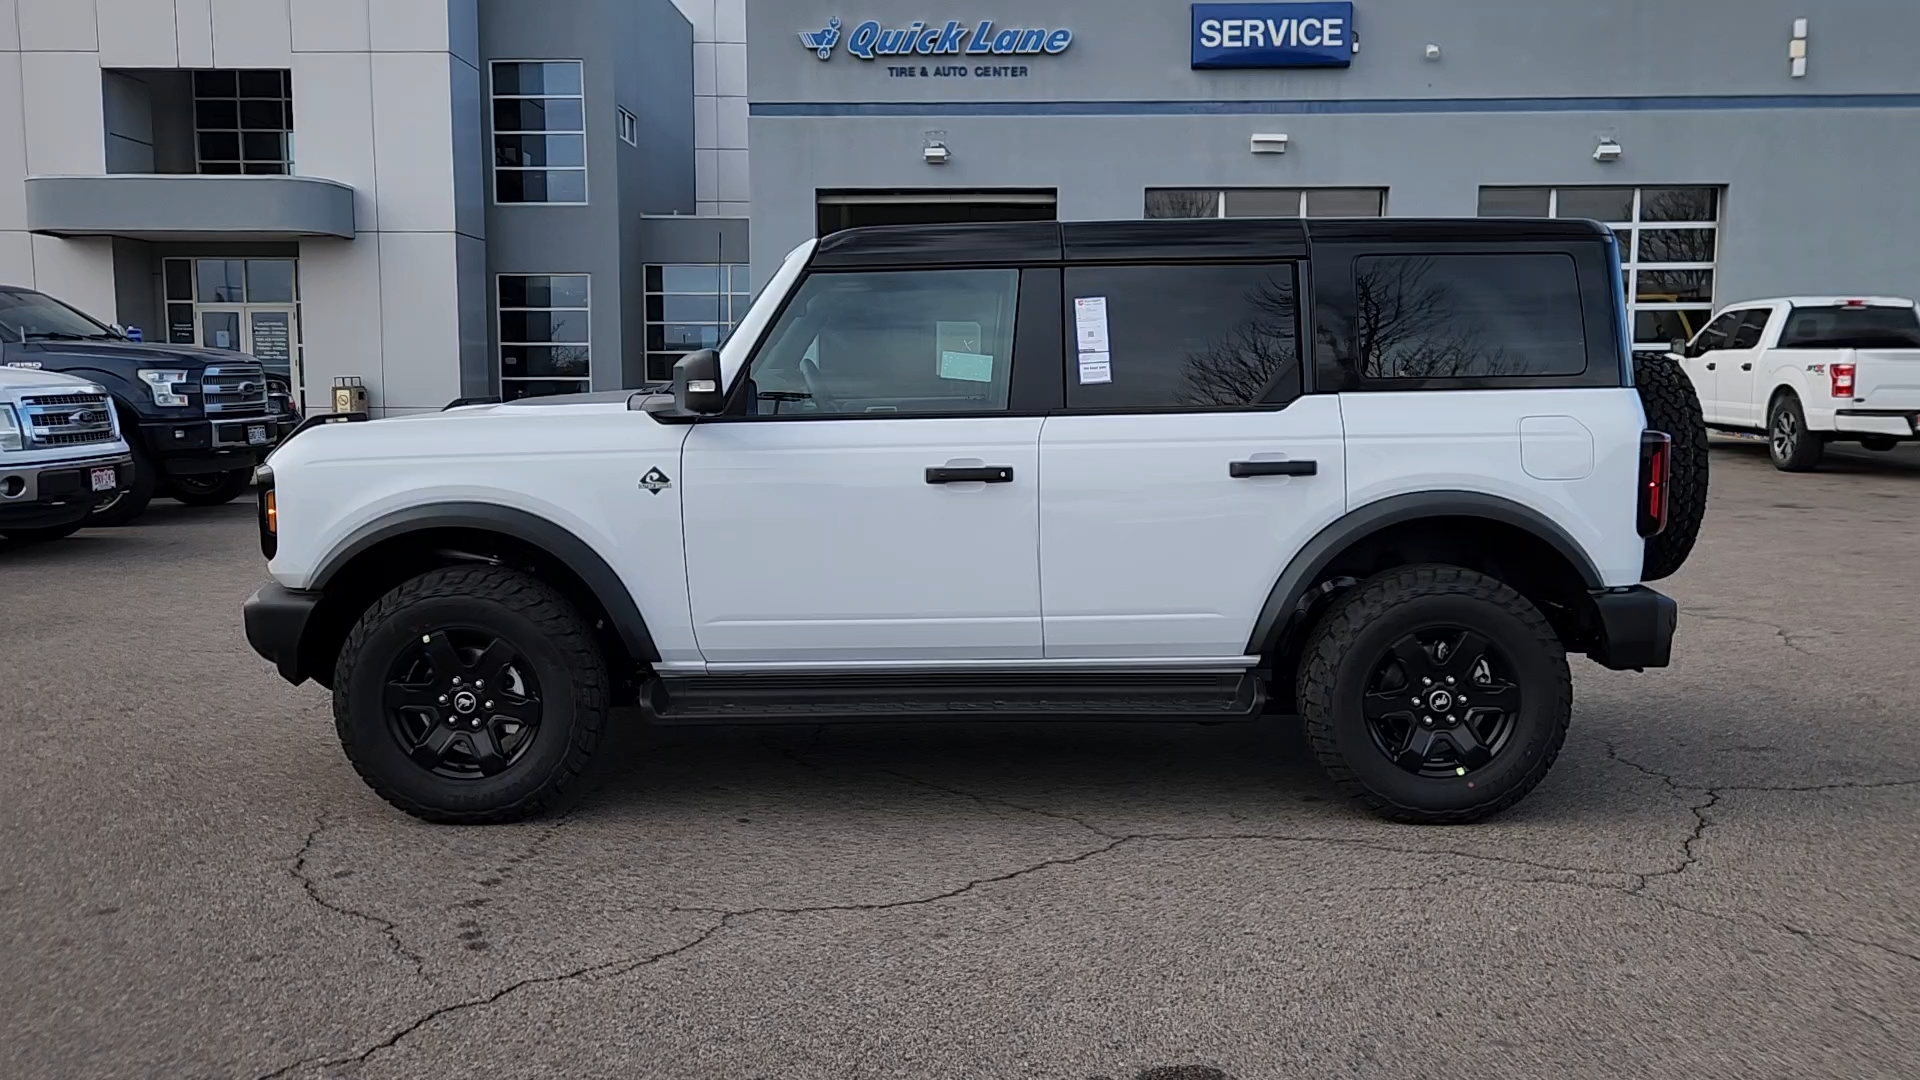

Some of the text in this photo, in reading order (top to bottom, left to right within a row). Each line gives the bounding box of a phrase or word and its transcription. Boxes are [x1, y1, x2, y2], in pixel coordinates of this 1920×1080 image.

[847, 20, 1072, 58] Quick Lane
[1200, 18, 1343, 47] SERVICE
[887, 66, 1029, 77] TIRE & AUTO CENTER
